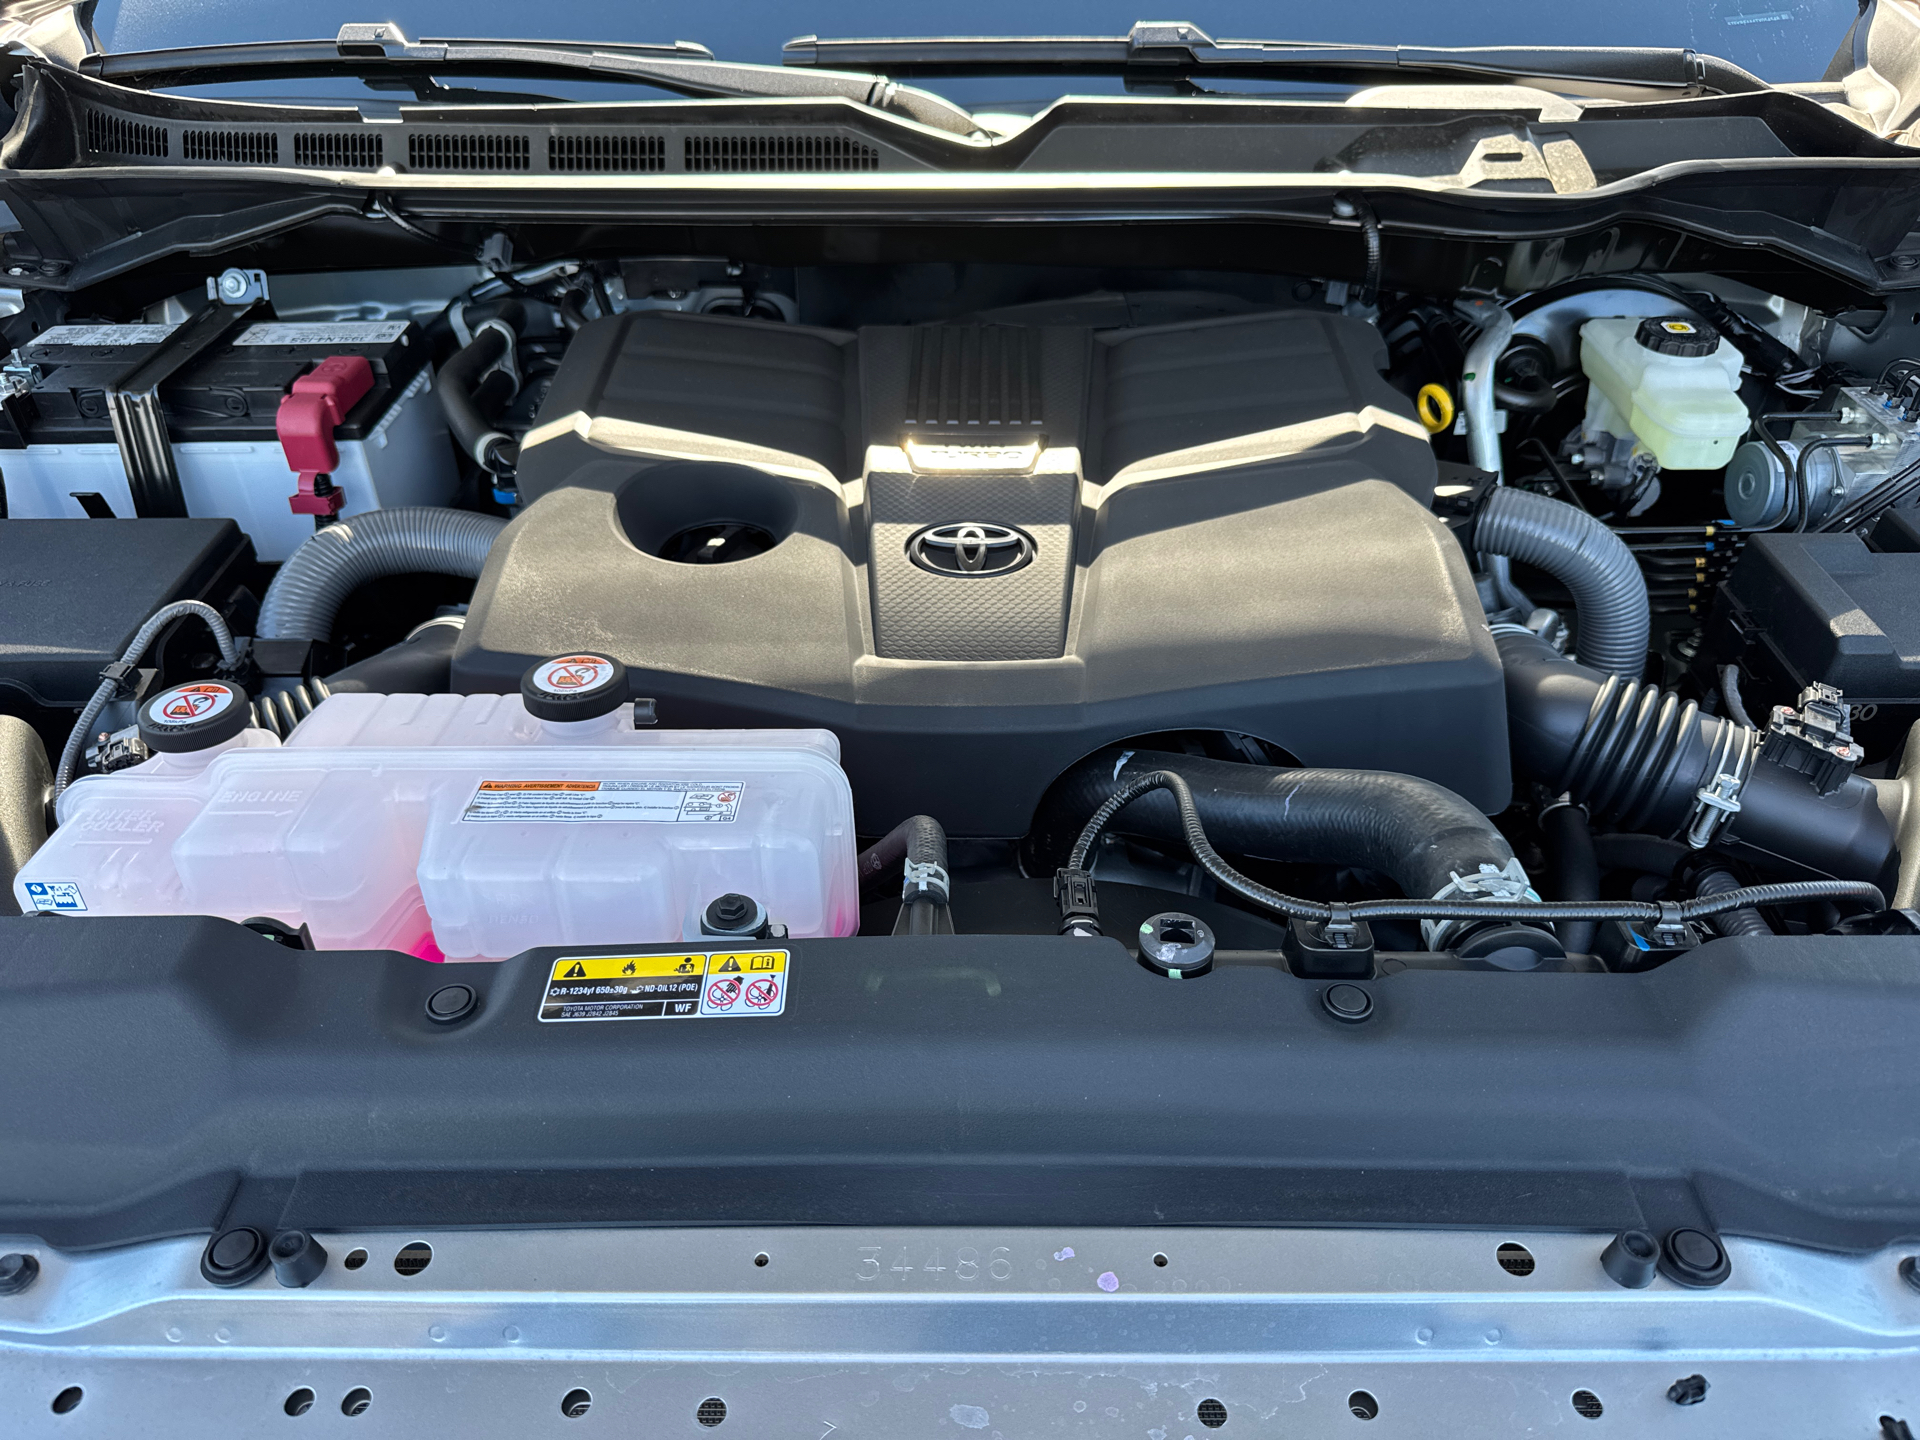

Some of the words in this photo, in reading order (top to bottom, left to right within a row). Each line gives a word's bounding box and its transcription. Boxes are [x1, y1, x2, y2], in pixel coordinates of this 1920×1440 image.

[218, 789, 304, 804] ENGINE
[86, 807, 157, 821] INTER
[80, 819, 165, 834] COOLER
[488, 914, 539, 924] DENSO
[560, 986, 594, 996] R-1234yf
[595, 985, 628, 995] 650±30g
[605, 1003, 644, 1011] CORPORATION
[674, 1003, 692, 1013] WF
[855, 1246, 1012, 1282] 34486
